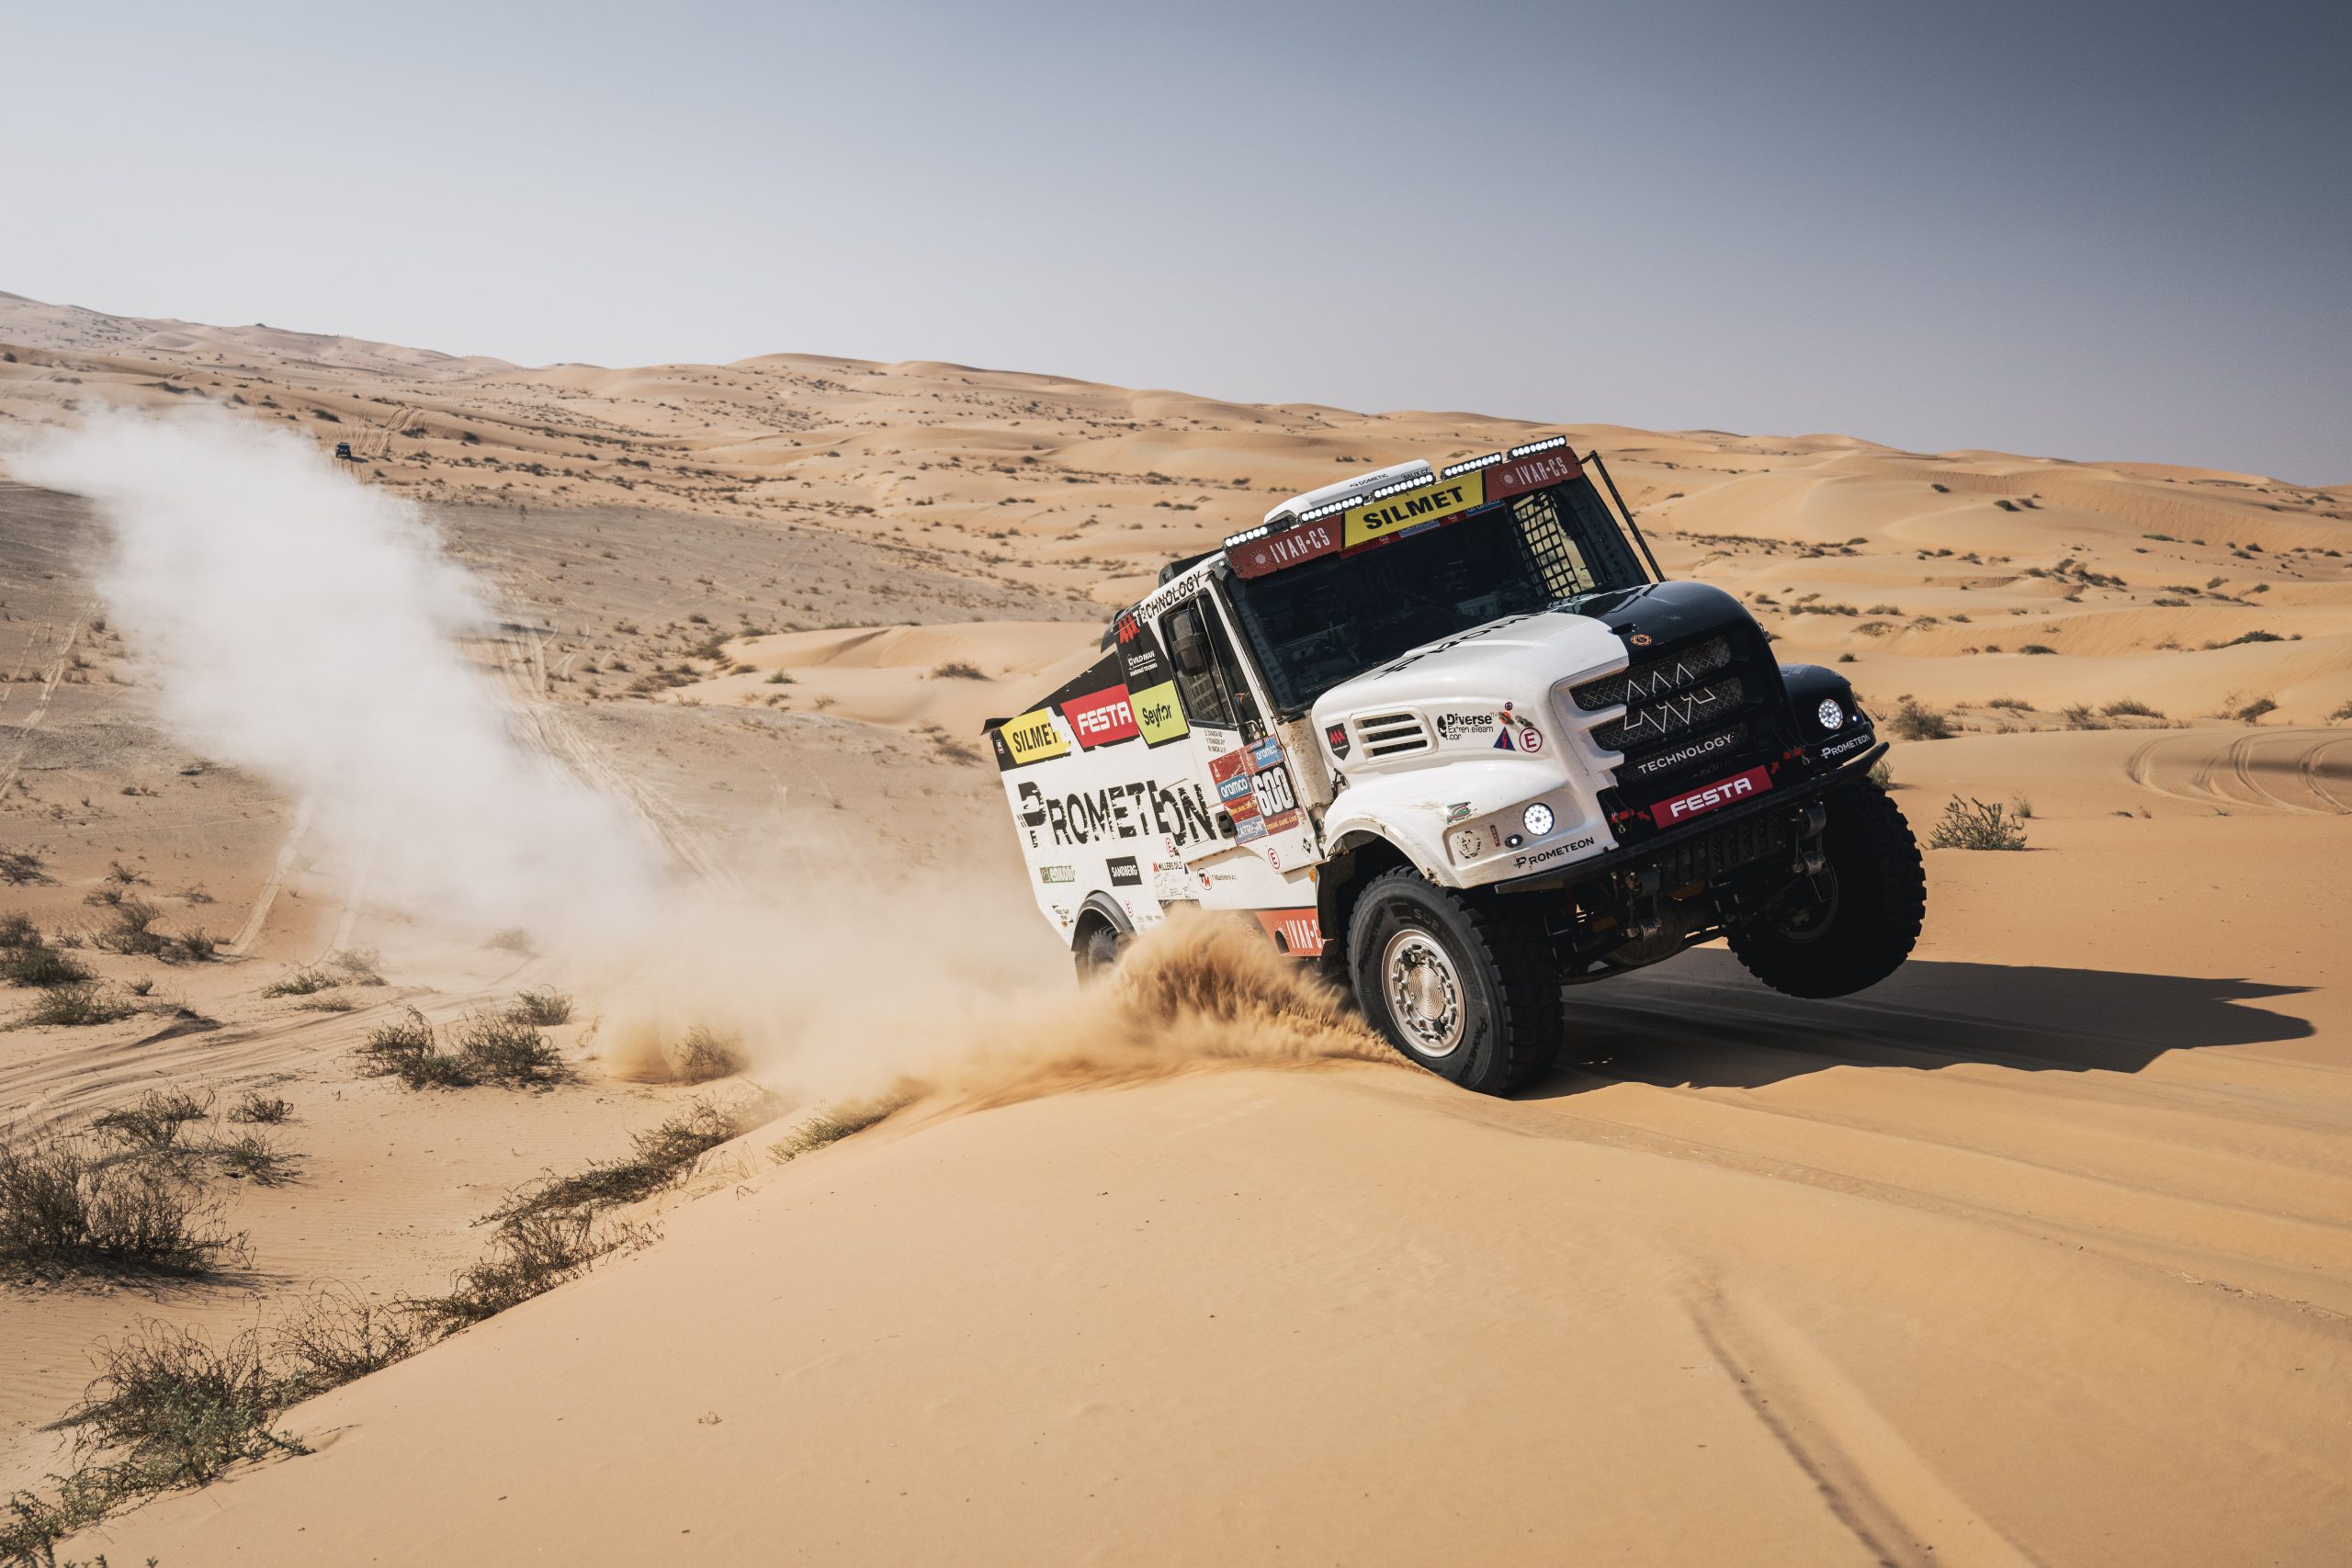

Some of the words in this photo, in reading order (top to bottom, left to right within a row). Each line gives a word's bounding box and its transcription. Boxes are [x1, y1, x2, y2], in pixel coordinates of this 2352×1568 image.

[1358, 473, 1388, 487] DOMETIC
[1363, 486, 1464, 530] SILMET
[1133, 570, 1201, 627] TECHNOLOGY
[1077, 701, 1132, 736] FESTA
[1142, 703, 1172, 728] Seyfor
[1447, 714, 1492, 726] Diverse
[1012, 722, 1058, 753] SILMET
[1255, 744, 1278, 761] aramco
[1820, 733, 1871, 760] PROMETEON
[1638, 734, 1733, 774] TECHNOLOGY
[1220, 778, 1249, 797] aramco
[1251, 766, 1295, 817] 600
[1669, 777, 1752, 818] FESTA
[1513, 837, 1594, 870] PROMETEON
[1111, 864, 1138, 877] SANDBERG
